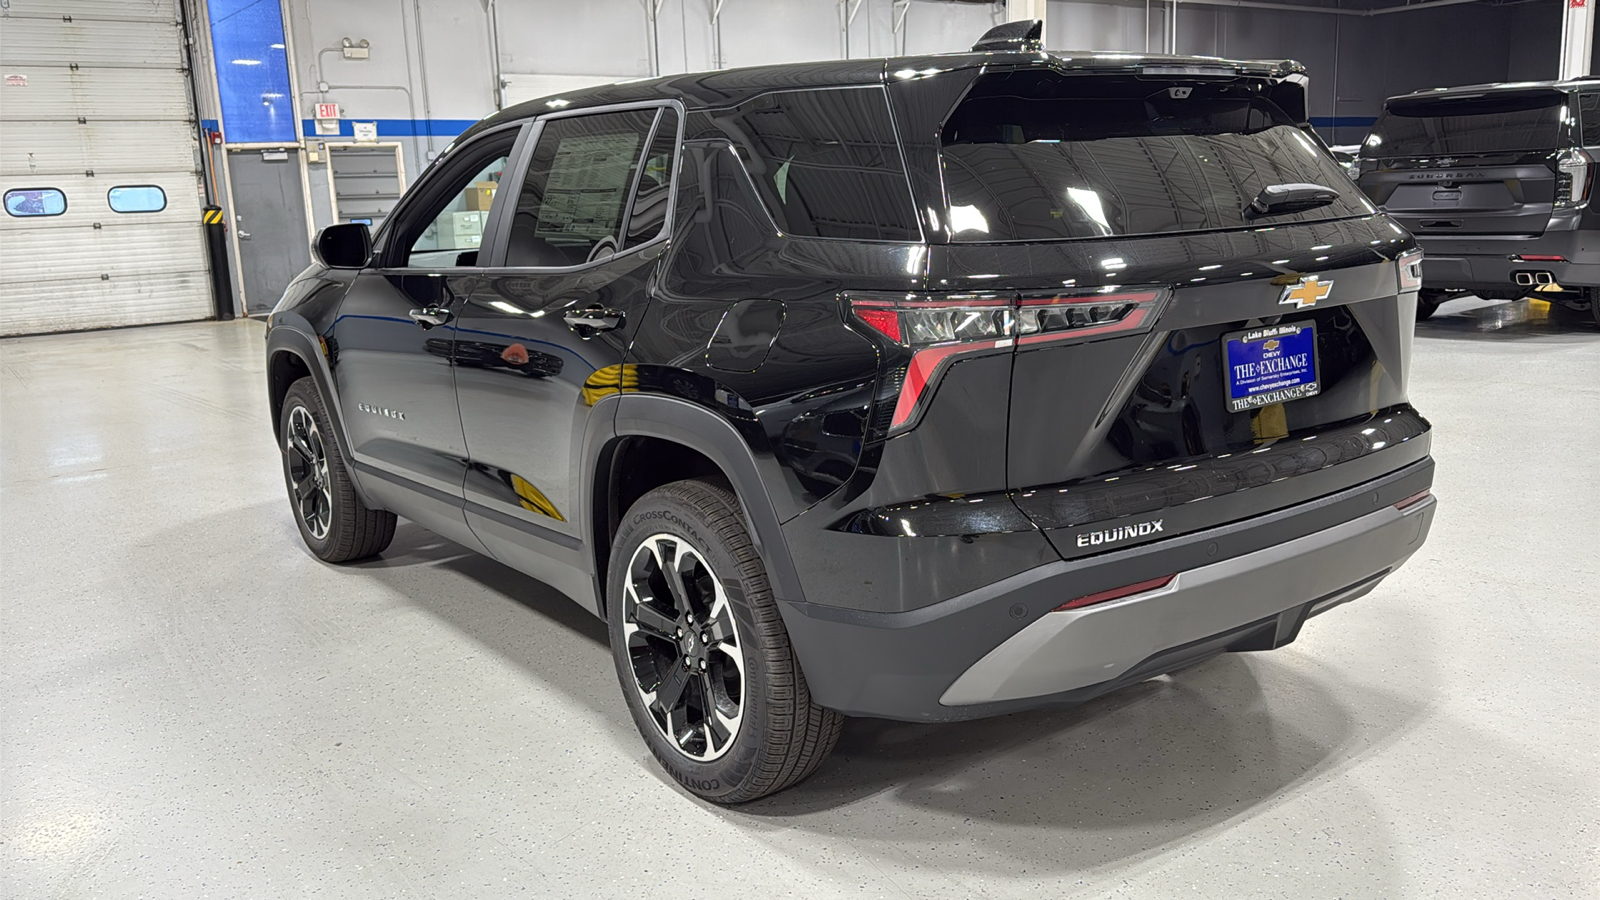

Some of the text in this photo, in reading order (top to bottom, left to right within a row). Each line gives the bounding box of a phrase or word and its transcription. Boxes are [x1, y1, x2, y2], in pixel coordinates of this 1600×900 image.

[320, 104, 337, 118] EXIT
[1248, 331, 1262, 339] Lake
[1263, 351, 1280, 359] CHEVY
[1234, 353, 1308, 379] THE EXCHANGE
[1248, 378, 1300, 393] www.chevyexchange.com
[1232, 387, 1302, 410] THE EXCHANGE
[358, 403, 406, 421] EQUINOX
[1077, 519, 1164, 547] EQUINOX
